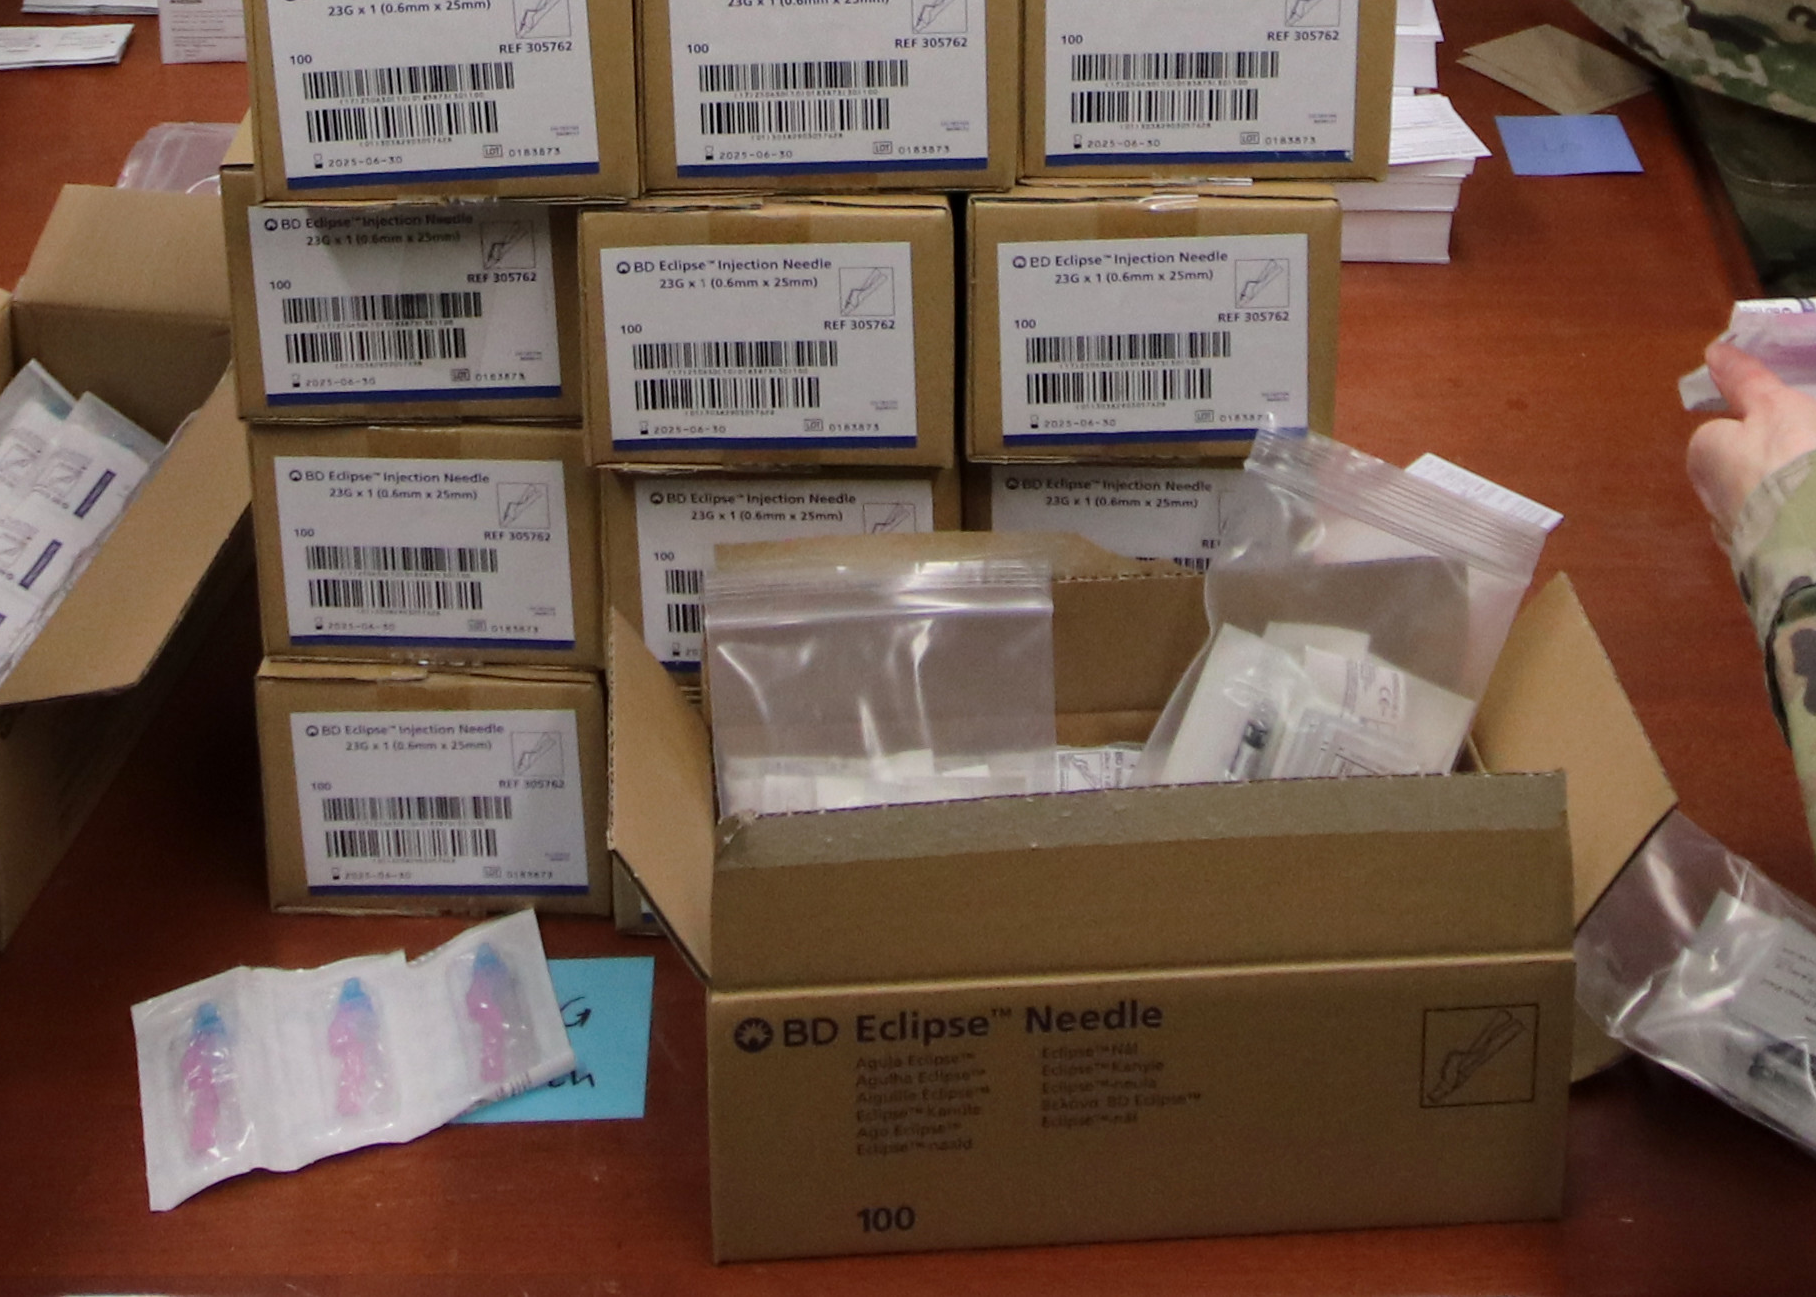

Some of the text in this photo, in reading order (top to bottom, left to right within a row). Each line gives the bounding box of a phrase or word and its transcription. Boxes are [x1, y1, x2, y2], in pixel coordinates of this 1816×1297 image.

[327, 5, 353, 16] 23G
[380, 0, 430, 15] (0.6mm
[1061, 35, 1082, 44] 100
[1267, 30, 1339, 41] REF 305762
[499, 39, 572, 53] REF 305762
[686, 44, 709, 54] 100
[895, 37, 967, 49] REF 305762
[289, 53, 312, 63] 100
[1114, 252, 1174, 266] Injection
[1179, 249, 1227, 262] Needle
[633, 261, 654, 272] BD
[717, 258, 778, 273] Injection
[783, 257, 831, 269] Needle
[1055, 273, 1079, 283] 23G
[1169, 269, 1213, 281] 25mm)
[659, 279, 684, 289] 23G
[710, 277, 758, 289] (0.6mm
[773, 276, 818, 288] 25mm)
[1218, 311, 1289, 322] REF 305762
[620, 324, 642, 334] 100
[824, 320, 895, 330] REF 305762
[1014, 319, 1036, 328] 100
[783, 1017, 838, 1047] BD
[1025, 999, 1163, 1034] Needle
[856, 1205, 915, 1233] 100
